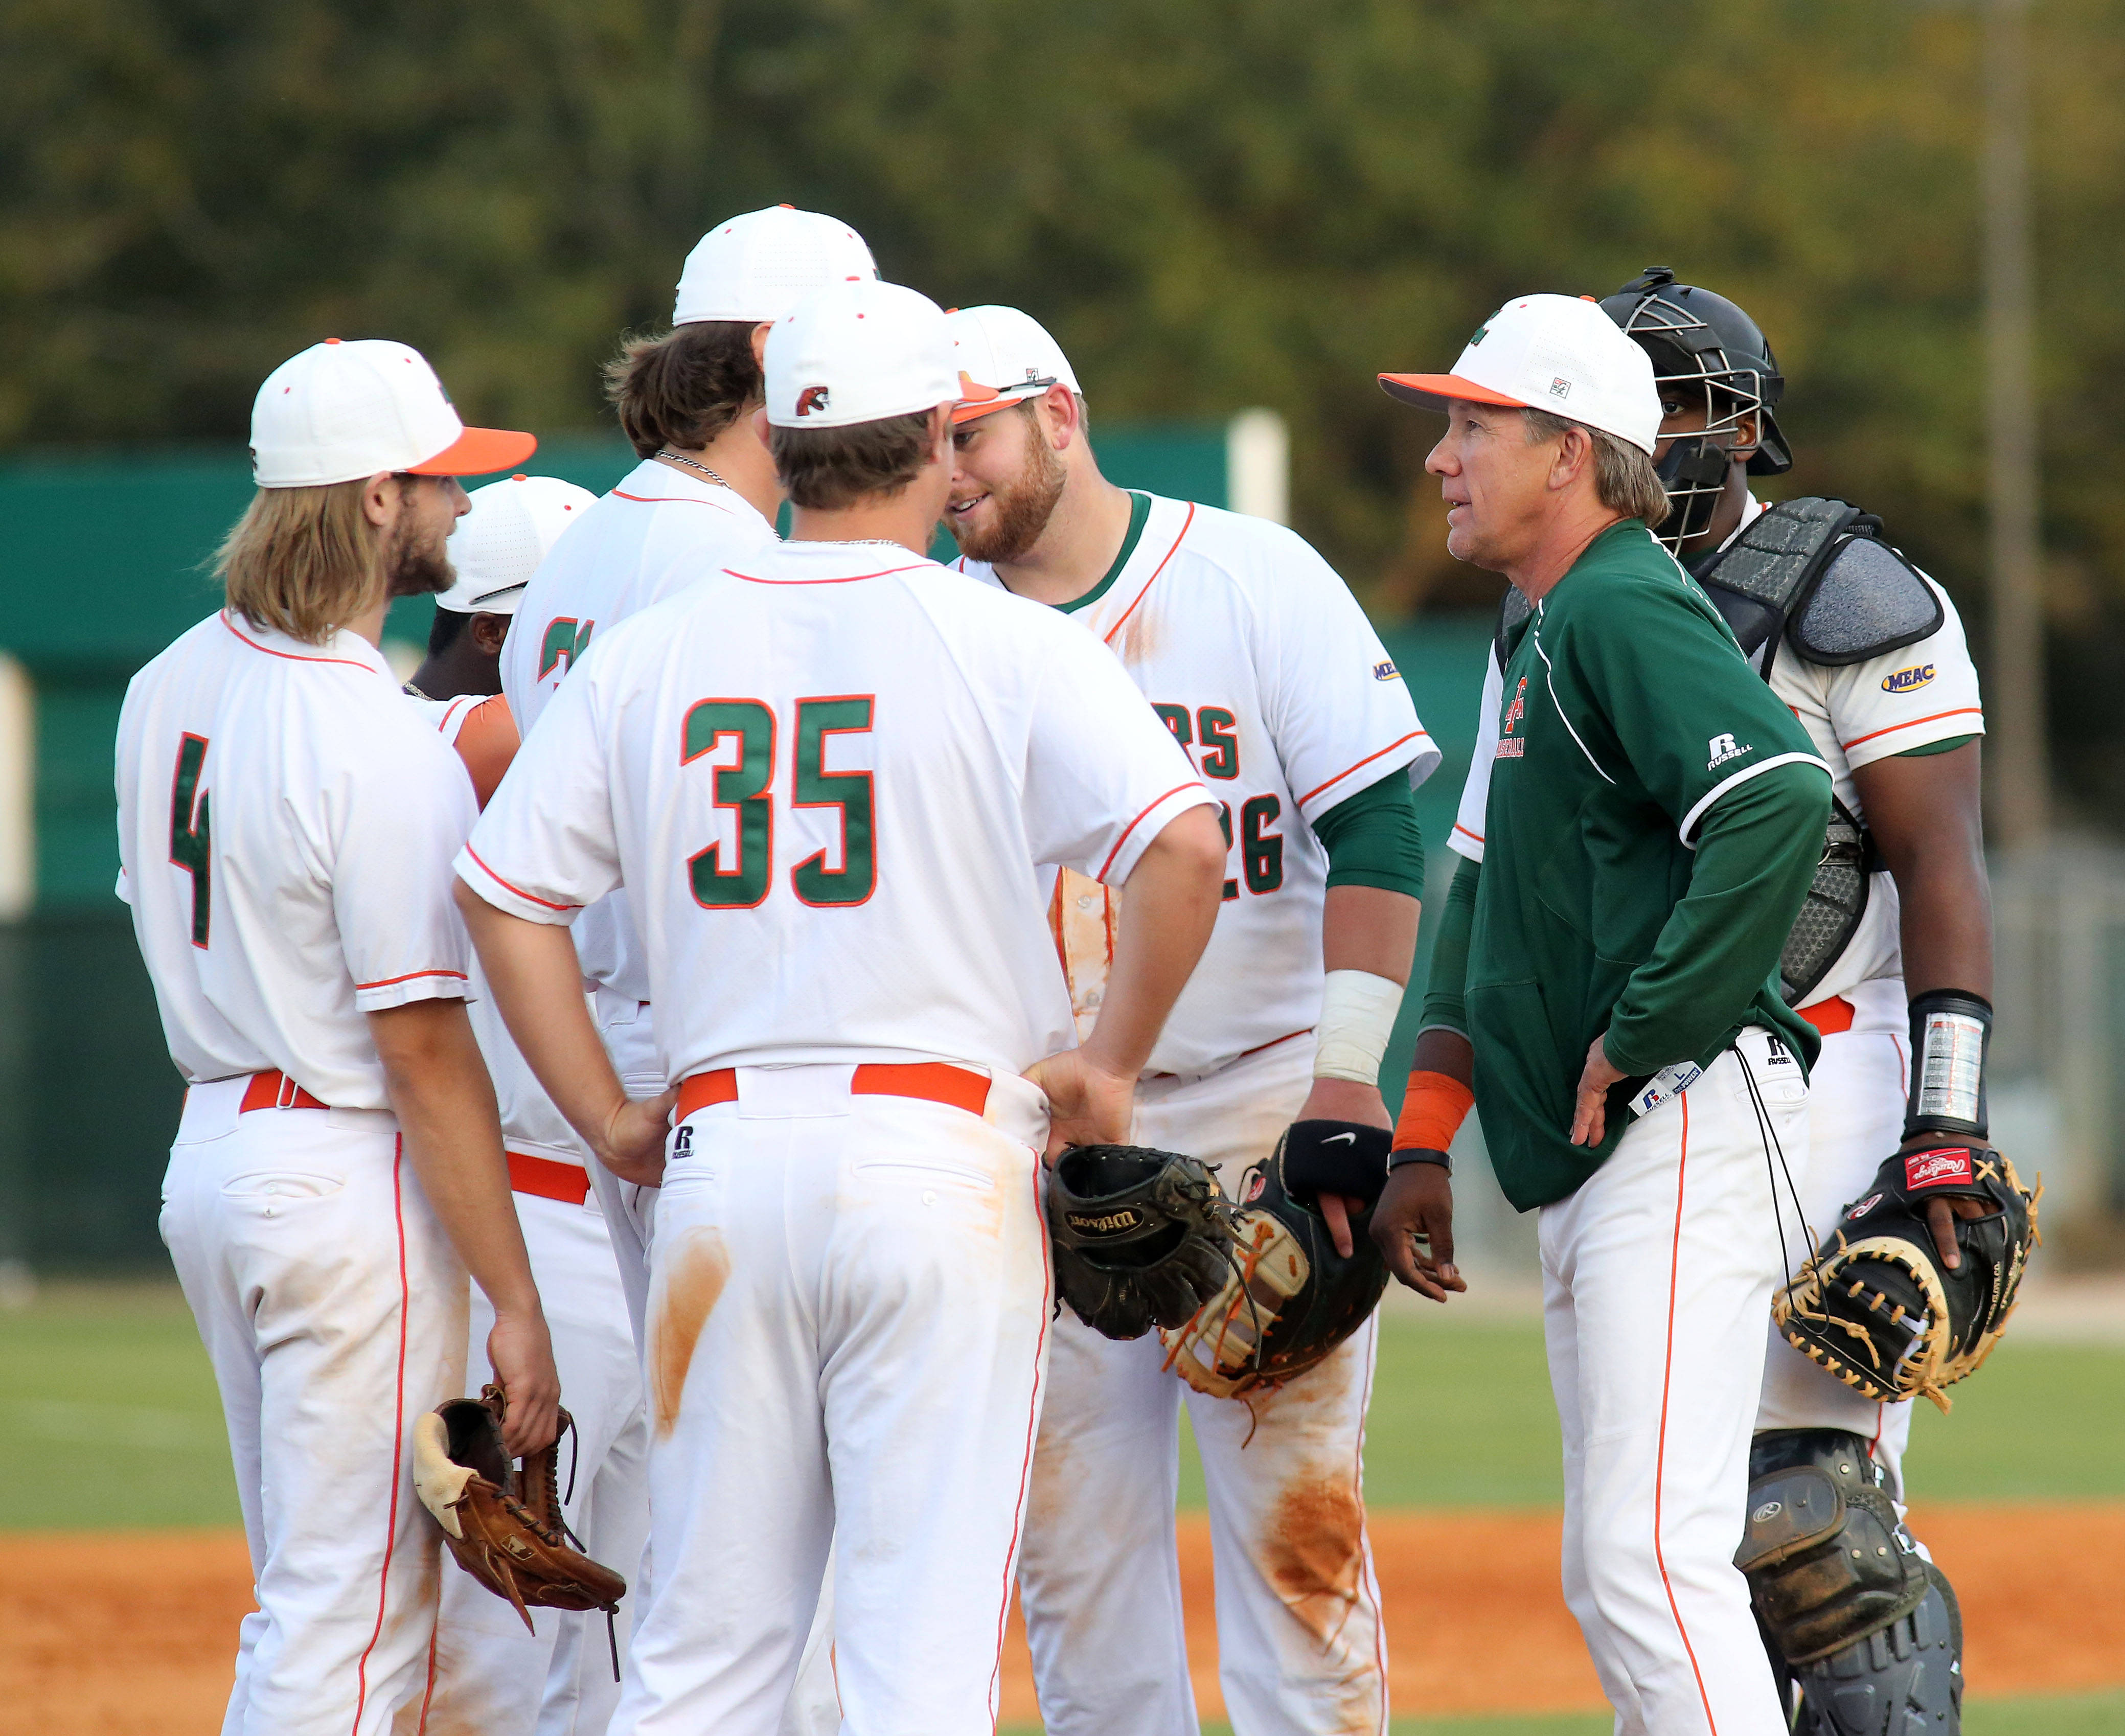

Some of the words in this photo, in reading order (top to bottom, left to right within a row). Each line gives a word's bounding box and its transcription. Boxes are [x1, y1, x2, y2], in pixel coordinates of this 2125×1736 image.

[1887, 664, 1934, 692] MEAC
[1496, 737, 1525, 759] ASEBALL
[1707, 744, 1753, 772] RUSSELL
[680, 694, 878, 910] 35
[169, 731, 211, 950] 4
[1768, 1057, 1792, 1066] RUSSELL
[1674, 1072, 1685, 1081] L
[1912, 1157, 1966, 1180] Rawlings
[1068, 1210, 1137, 1232] Wilson
